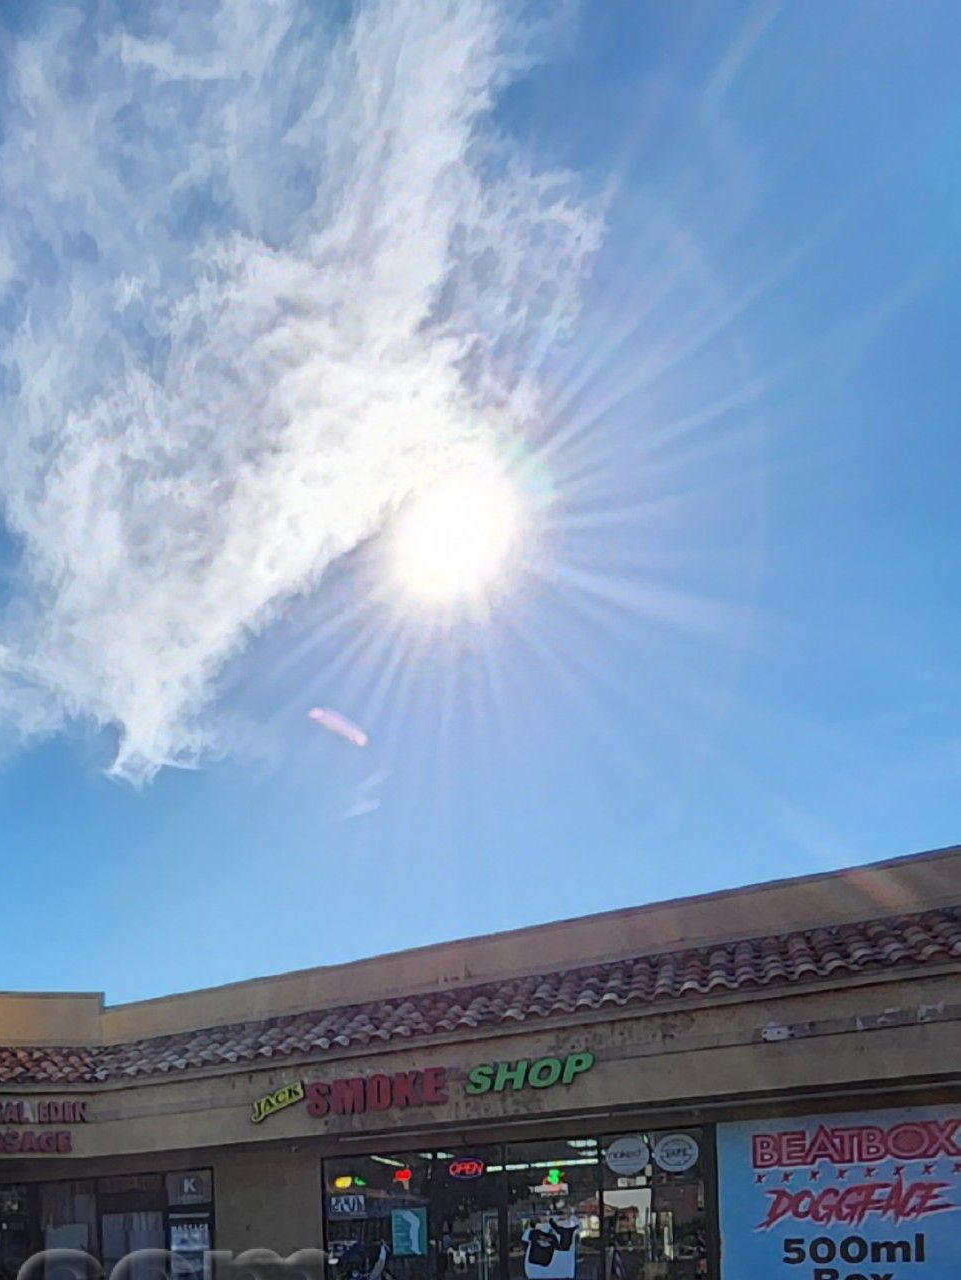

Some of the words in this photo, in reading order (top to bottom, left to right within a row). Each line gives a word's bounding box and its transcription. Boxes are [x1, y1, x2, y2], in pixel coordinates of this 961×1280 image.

[252, 1083, 301, 1120] JACK
[306, 1066, 449, 1119] SMOKE
[464, 1051, 596, 1095] SHOP
[752, 1119, 961, 1168] BEATBOX
[449, 1161, 484, 1176] OPEN
[754, 1172, 961, 1230] DOGGFACE
[782, 1233, 926, 1264] 500ml
